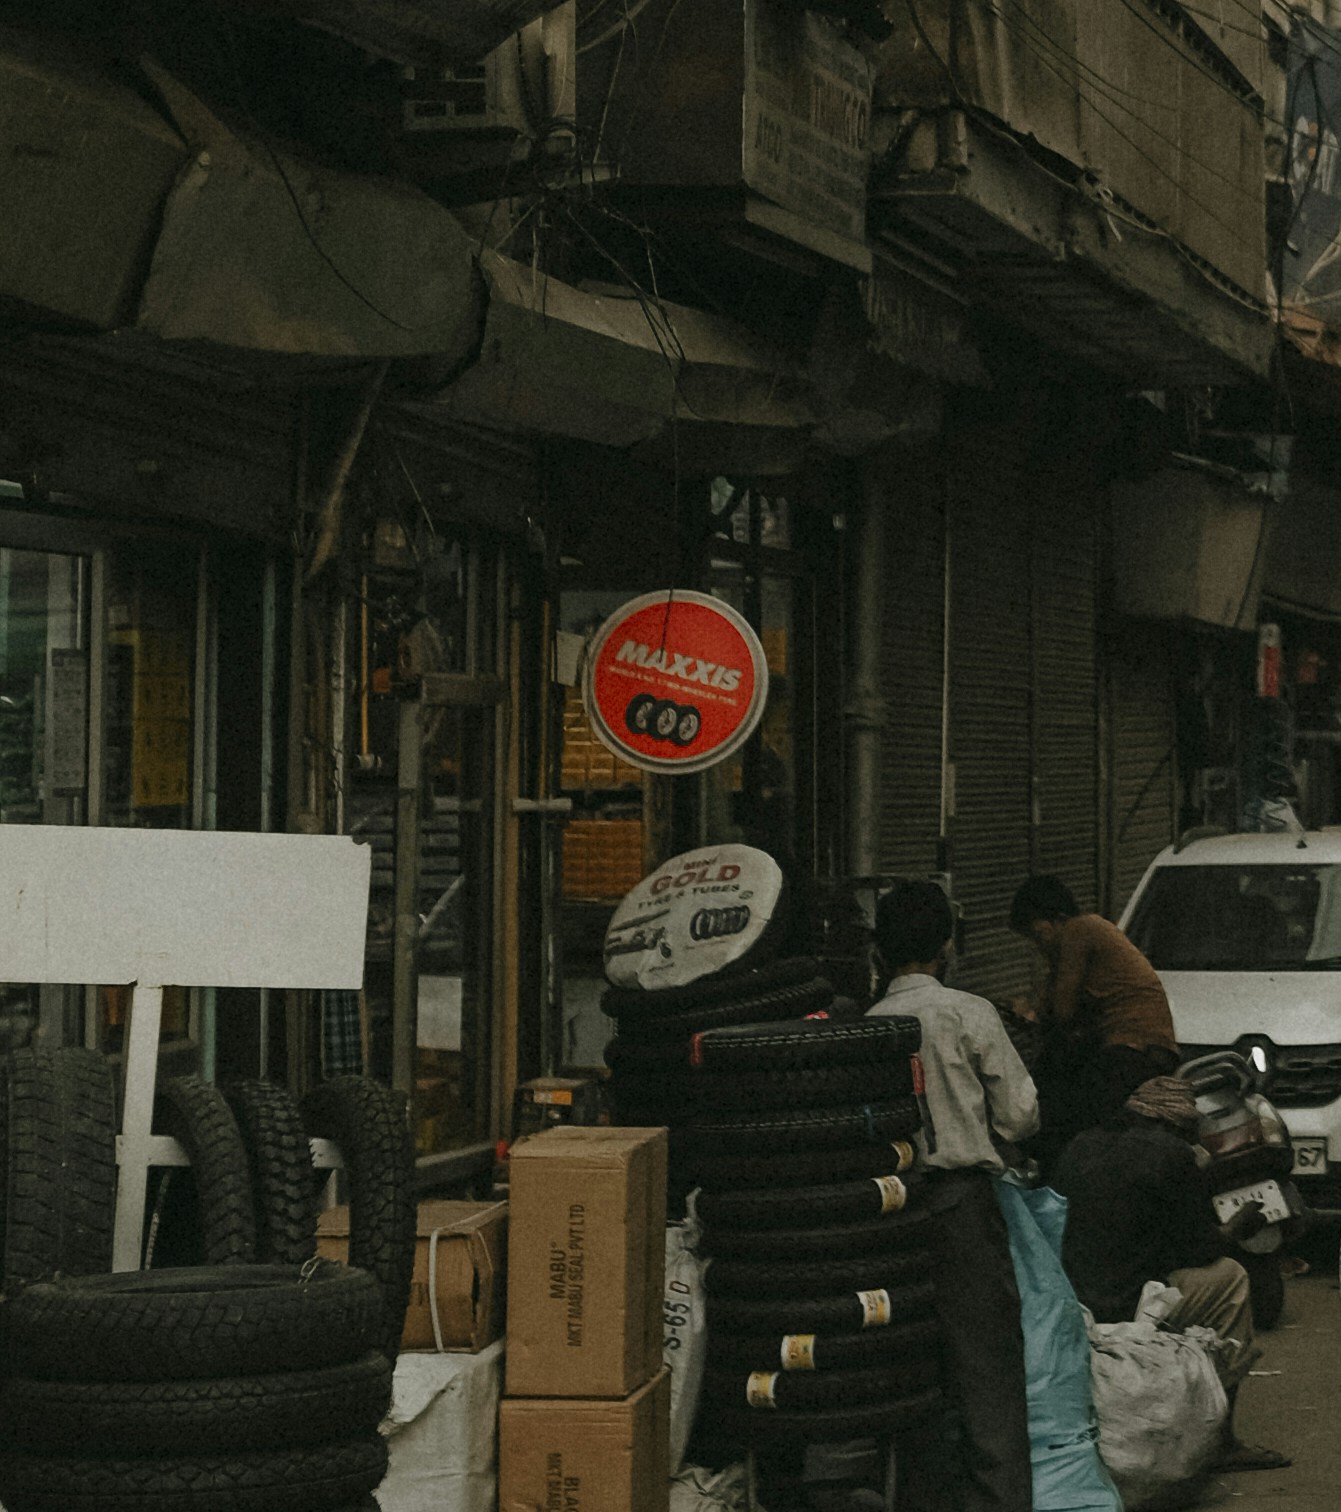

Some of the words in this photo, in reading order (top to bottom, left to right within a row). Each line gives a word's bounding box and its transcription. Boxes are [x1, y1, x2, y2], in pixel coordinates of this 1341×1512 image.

[616, 640, 742, 691] MAXXIS
[651, 864, 741, 895] GOLD
[569, 1204, 585, 1226] LTD
[568, 1228, 585, 1250] PVT
[568, 1253, 584, 1282] SEAL
[567, 1284, 583, 1319] MABU
[566, 1322, 583, 1348] MKT
